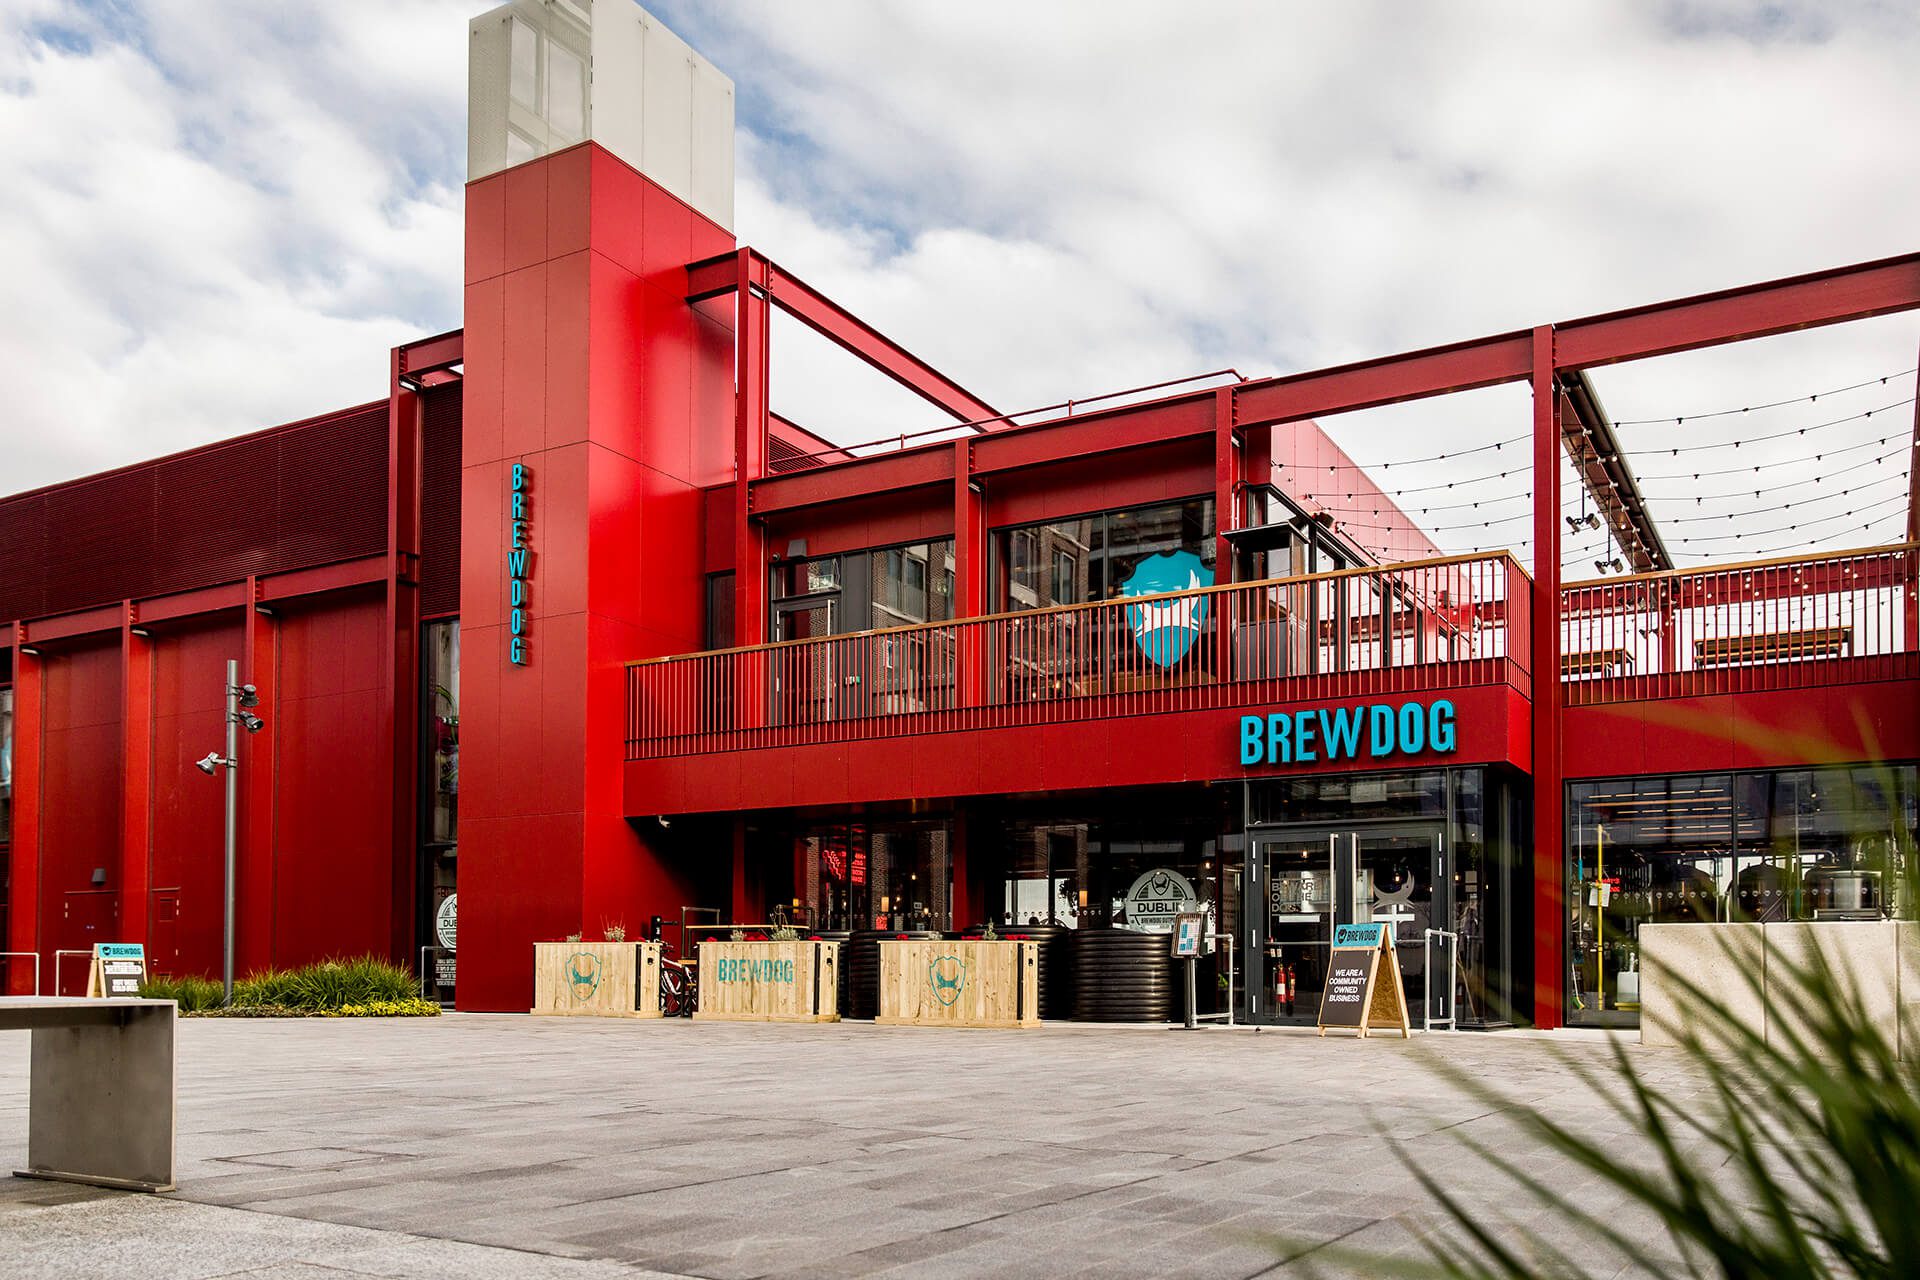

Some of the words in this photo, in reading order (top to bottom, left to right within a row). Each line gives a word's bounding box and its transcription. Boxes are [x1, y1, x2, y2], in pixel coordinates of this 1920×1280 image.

[507, 463, 528, 665] BREWDOG
[1240, 699, 1456, 766] BREWDOG
[1346, 930, 1377, 942] BREWDOG
[718, 959, 793, 983] BREWDOG
[1335, 969, 1347, 977] WE
[1347, 969, 1358, 977] ARE
[1333, 986, 1358, 994] OWNED
